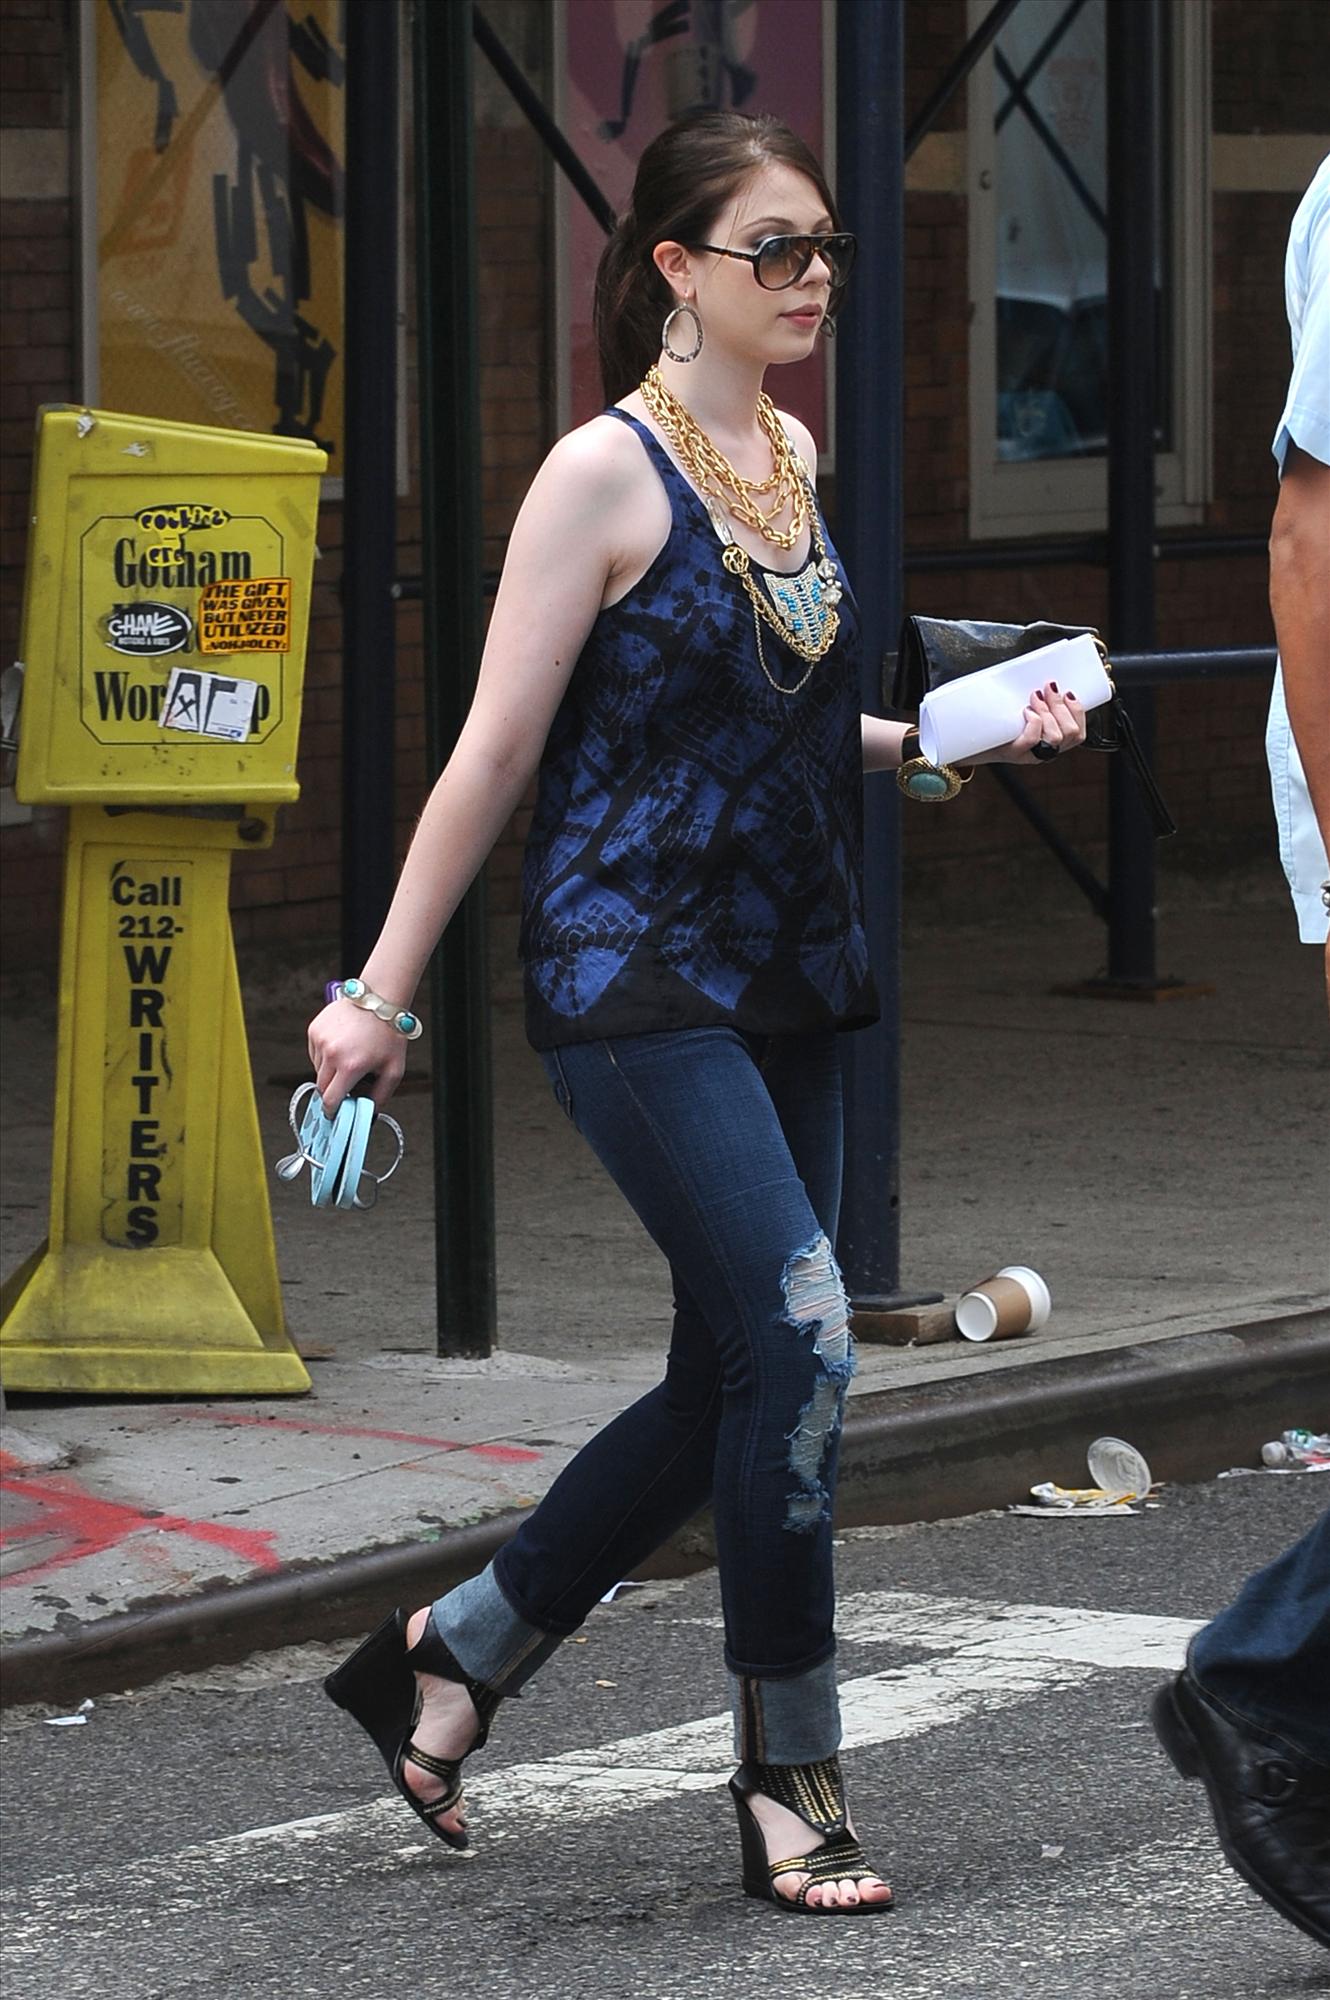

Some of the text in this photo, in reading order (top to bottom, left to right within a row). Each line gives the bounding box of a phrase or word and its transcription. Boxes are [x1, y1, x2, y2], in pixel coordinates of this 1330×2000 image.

[205, 582, 288, 598] THE GIFT
[203, 597, 287, 611] WAS GIVEN
[203, 610, 287, 623] BUT NEVER
[204, 623, 287, 638] UTILIZED
[94, 671, 270, 734] Worp
[112, 876, 182, 906] Call
[118, 915, 184, 939] 212-
[123, 945, 173, 1244] WRITERS
